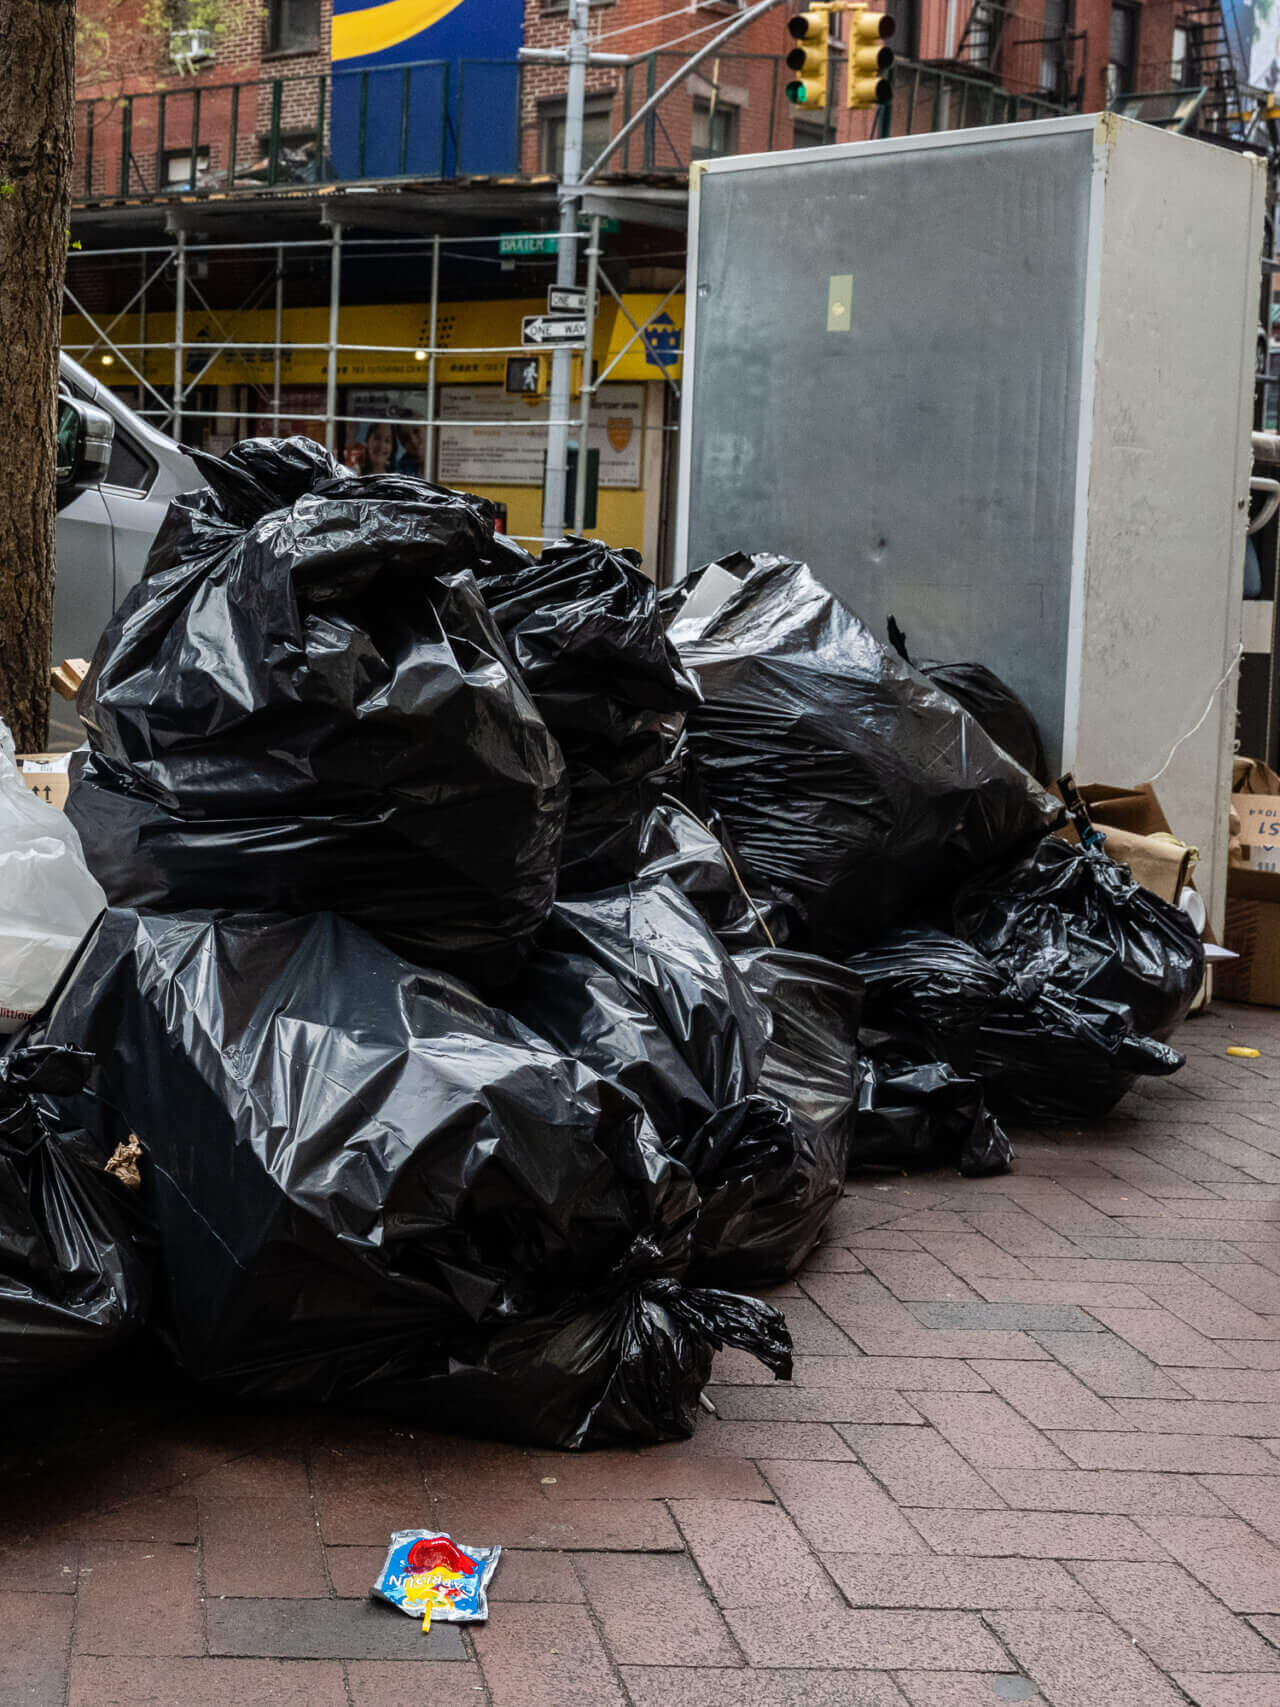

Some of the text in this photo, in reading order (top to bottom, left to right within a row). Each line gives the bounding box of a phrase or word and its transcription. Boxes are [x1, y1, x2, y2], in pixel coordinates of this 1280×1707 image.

[501, 238, 545, 251] BAXTER
[553, 295, 570, 305] ONE
[530, 325, 585, 337] ONE WAY
